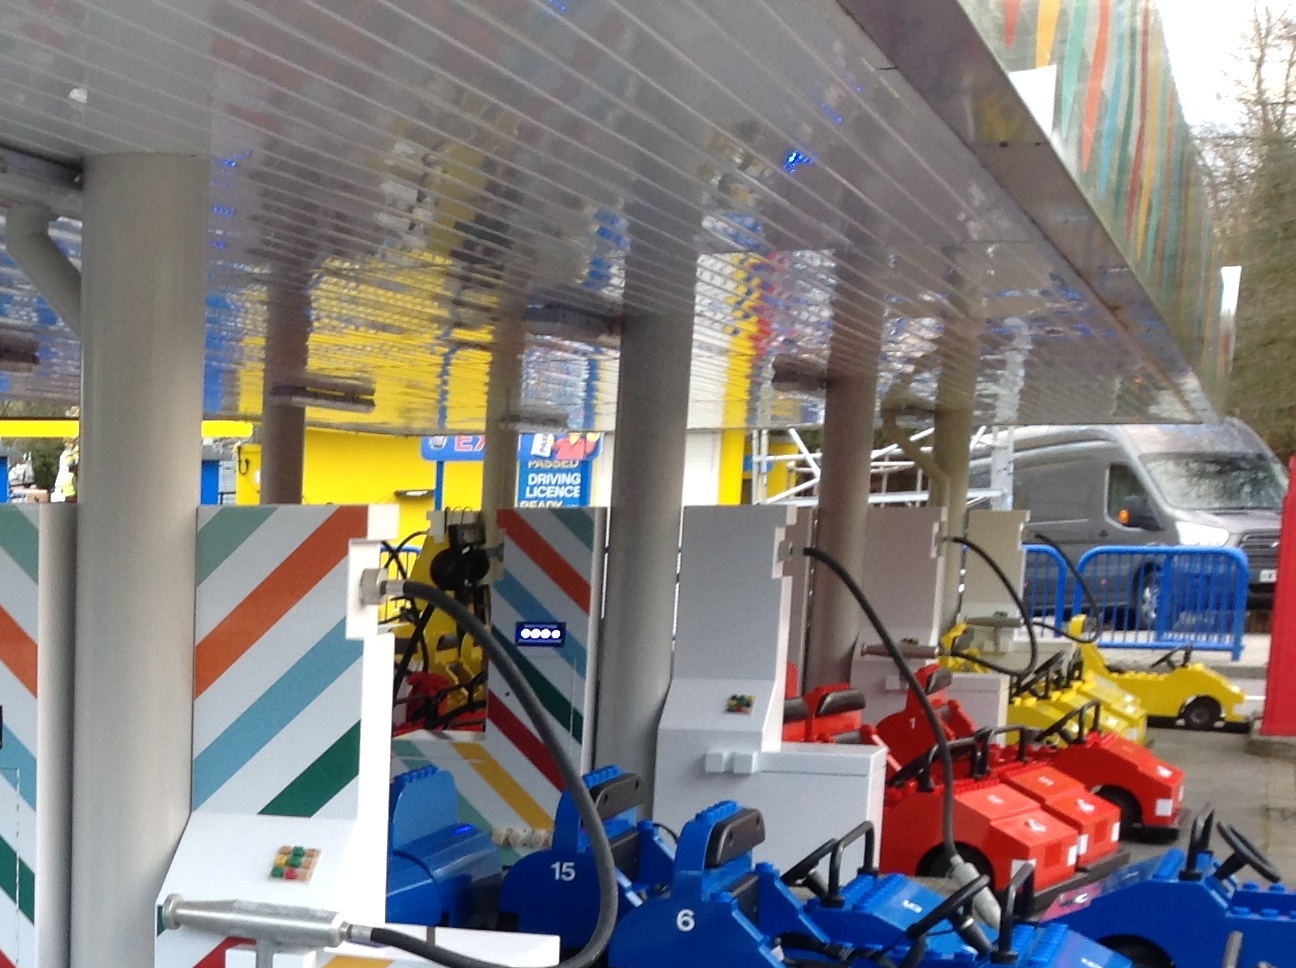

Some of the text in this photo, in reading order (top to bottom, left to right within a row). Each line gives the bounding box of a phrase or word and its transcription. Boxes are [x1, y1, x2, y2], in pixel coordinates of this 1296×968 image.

[527, 472, 581, 486] DRIVING
[525, 485, 581, 498] LICENCE
[551, 861, 576, 882] 15
[676, 908, 696, 932] 6
